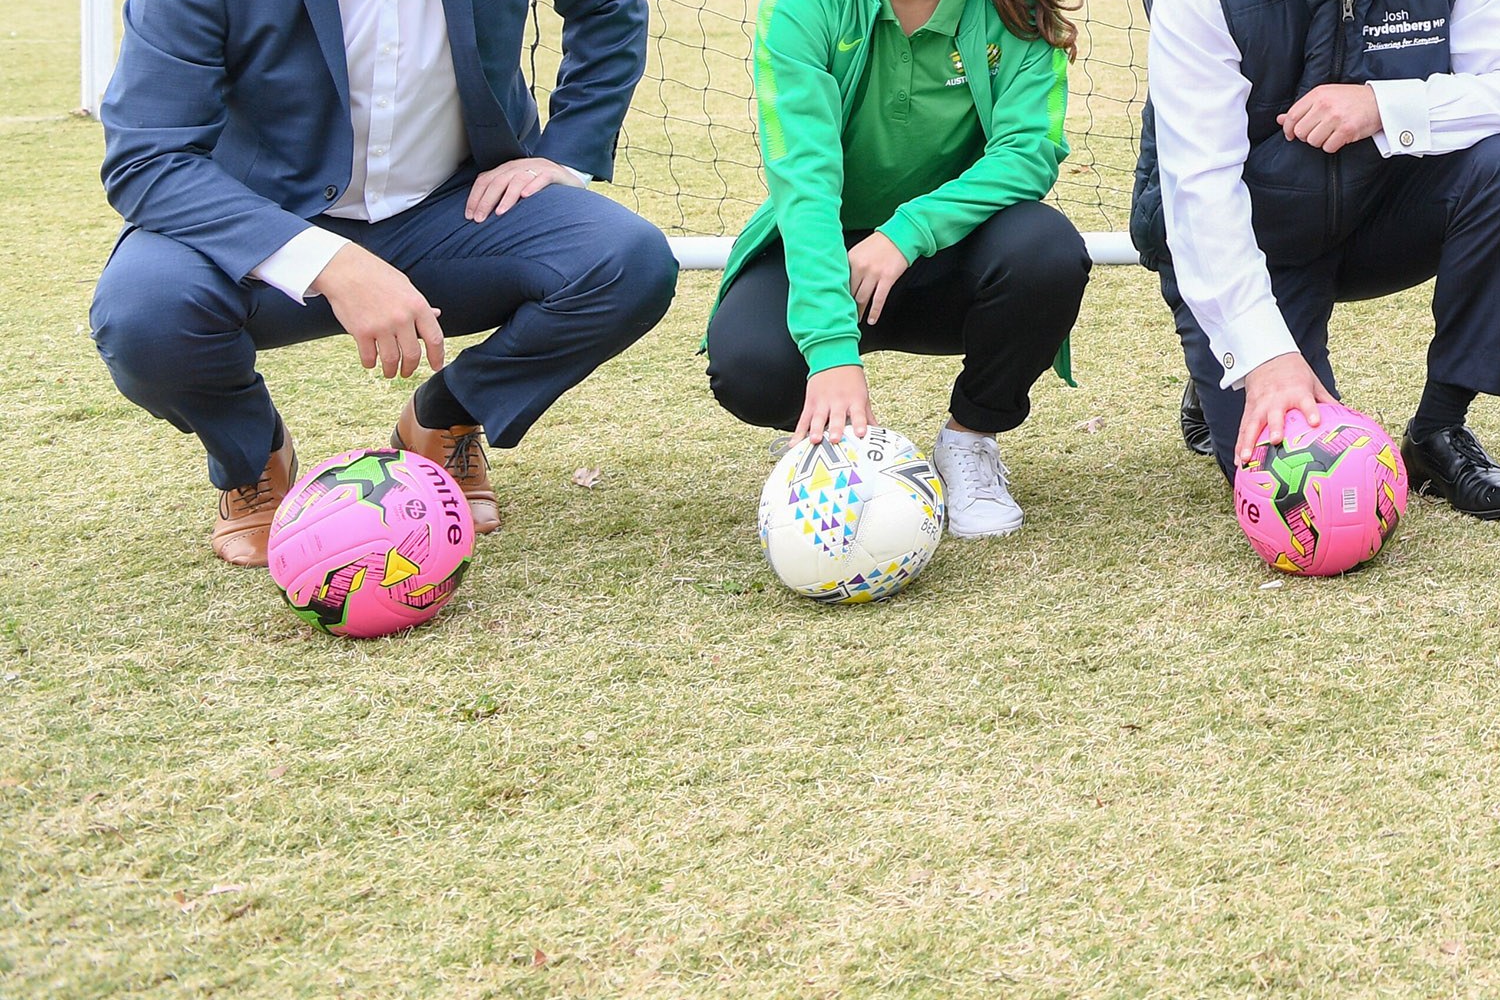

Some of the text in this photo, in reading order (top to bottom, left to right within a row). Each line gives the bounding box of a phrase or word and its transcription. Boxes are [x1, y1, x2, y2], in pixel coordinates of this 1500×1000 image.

[1382, 9, 1409, 22] Josh
[1362, 18, 1445, 37] Frydenberg MP
[418, 464, 462, 546] mitre
